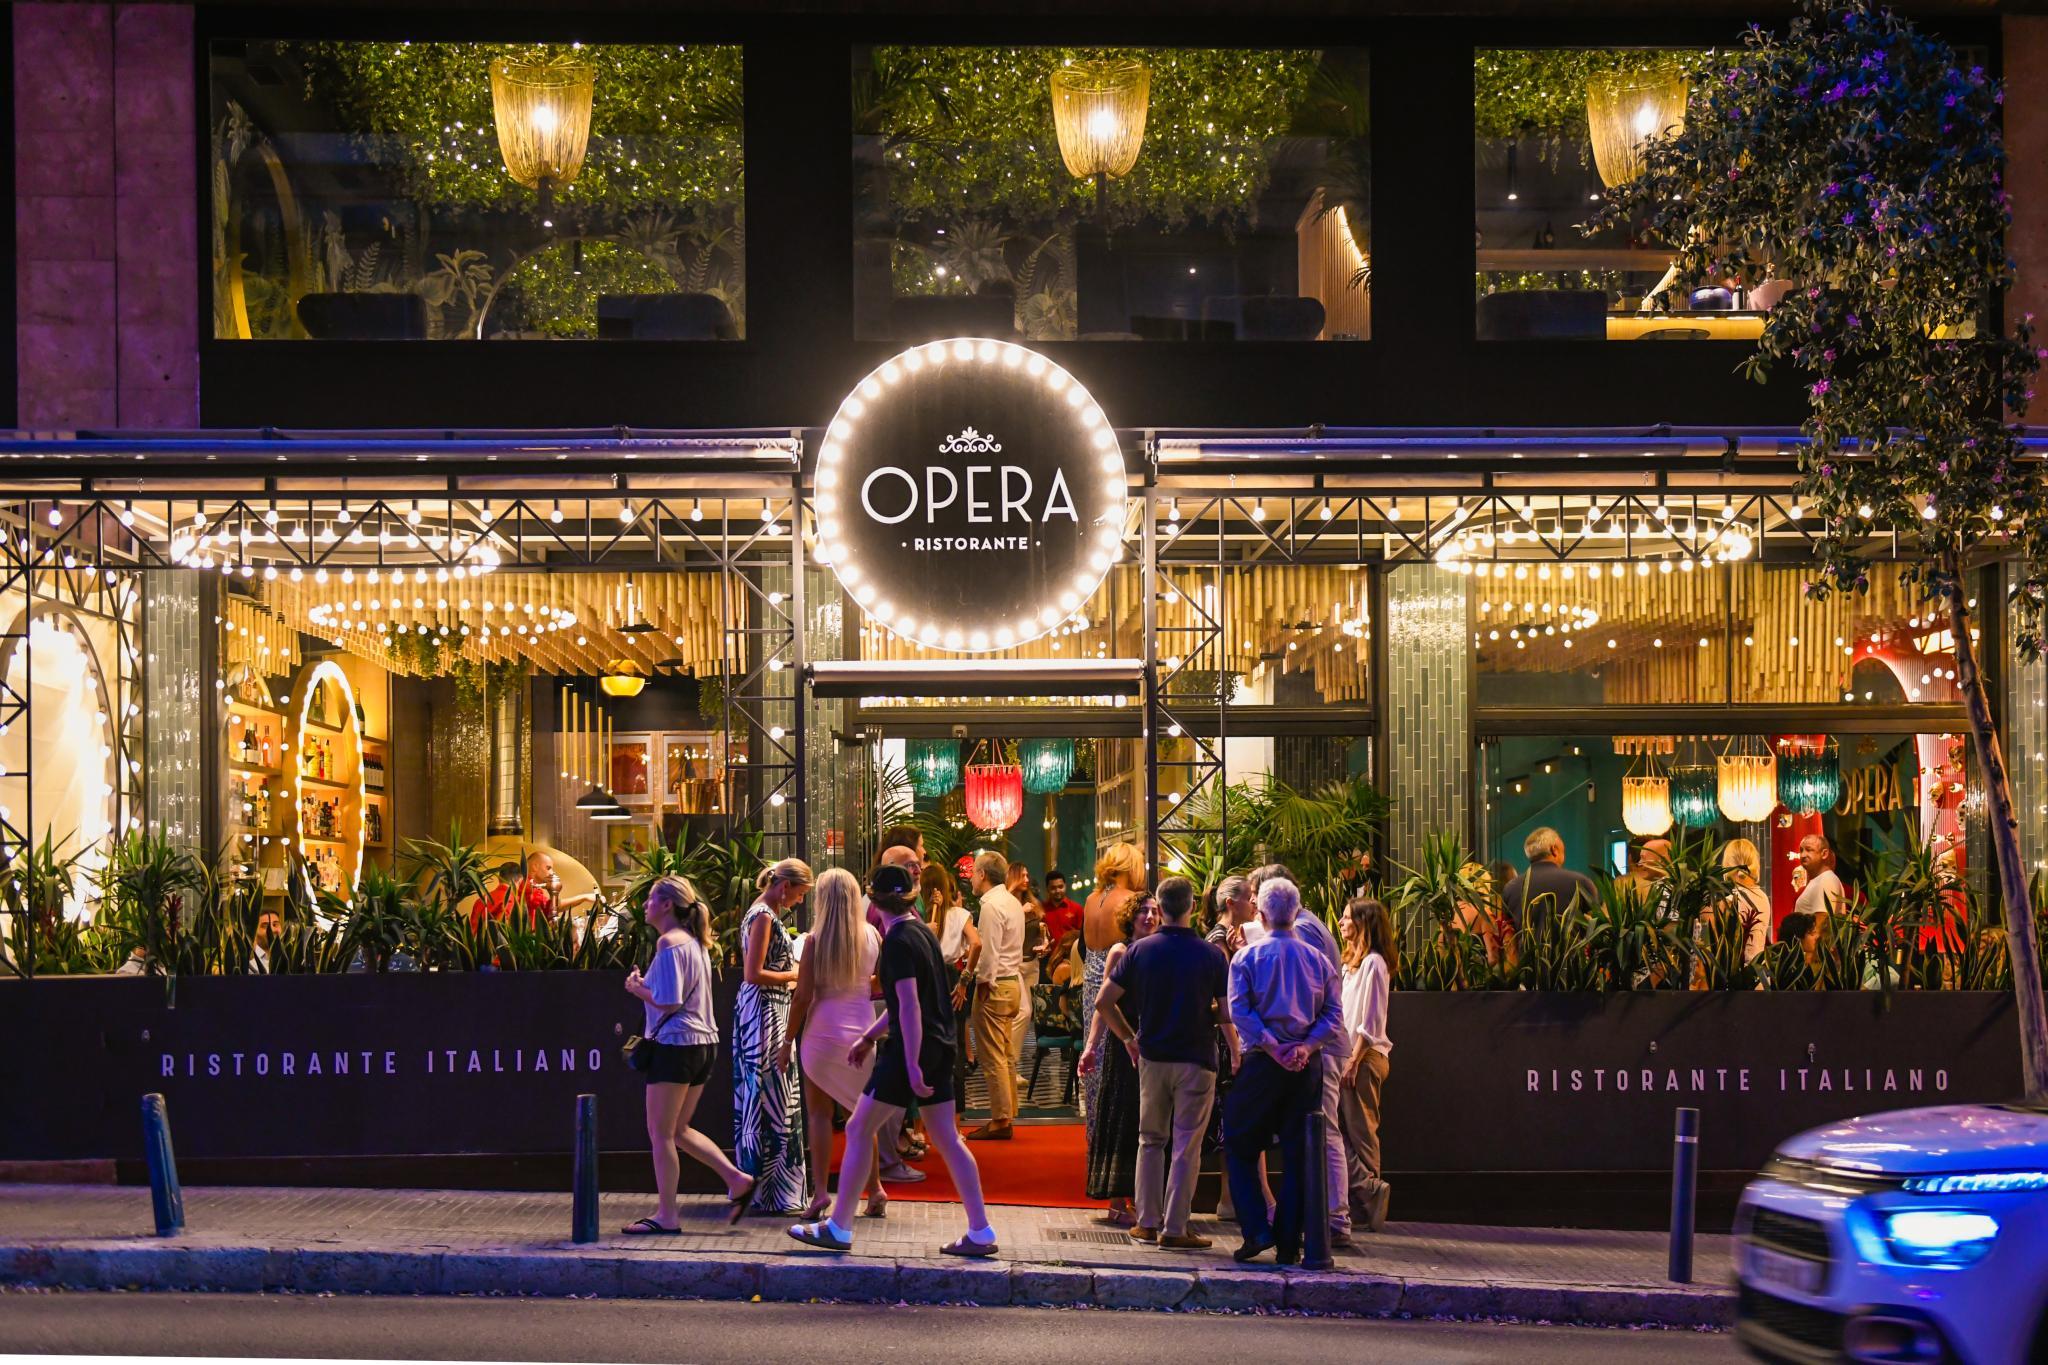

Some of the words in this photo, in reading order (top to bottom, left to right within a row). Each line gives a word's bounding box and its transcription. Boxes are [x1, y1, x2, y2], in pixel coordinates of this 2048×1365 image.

[860, 465, 1080, 525] OPERA
[914, 536, 1029, 551] RISTORANTE
[161, 1051, 397, 1077] RISTORANTE
[427, 1048, 602, 1074] ITALIANO
[1526, 1068, 1751, 1092] RISTORANTE
[1780, 1068, 1949, 1092] ITALIANO
